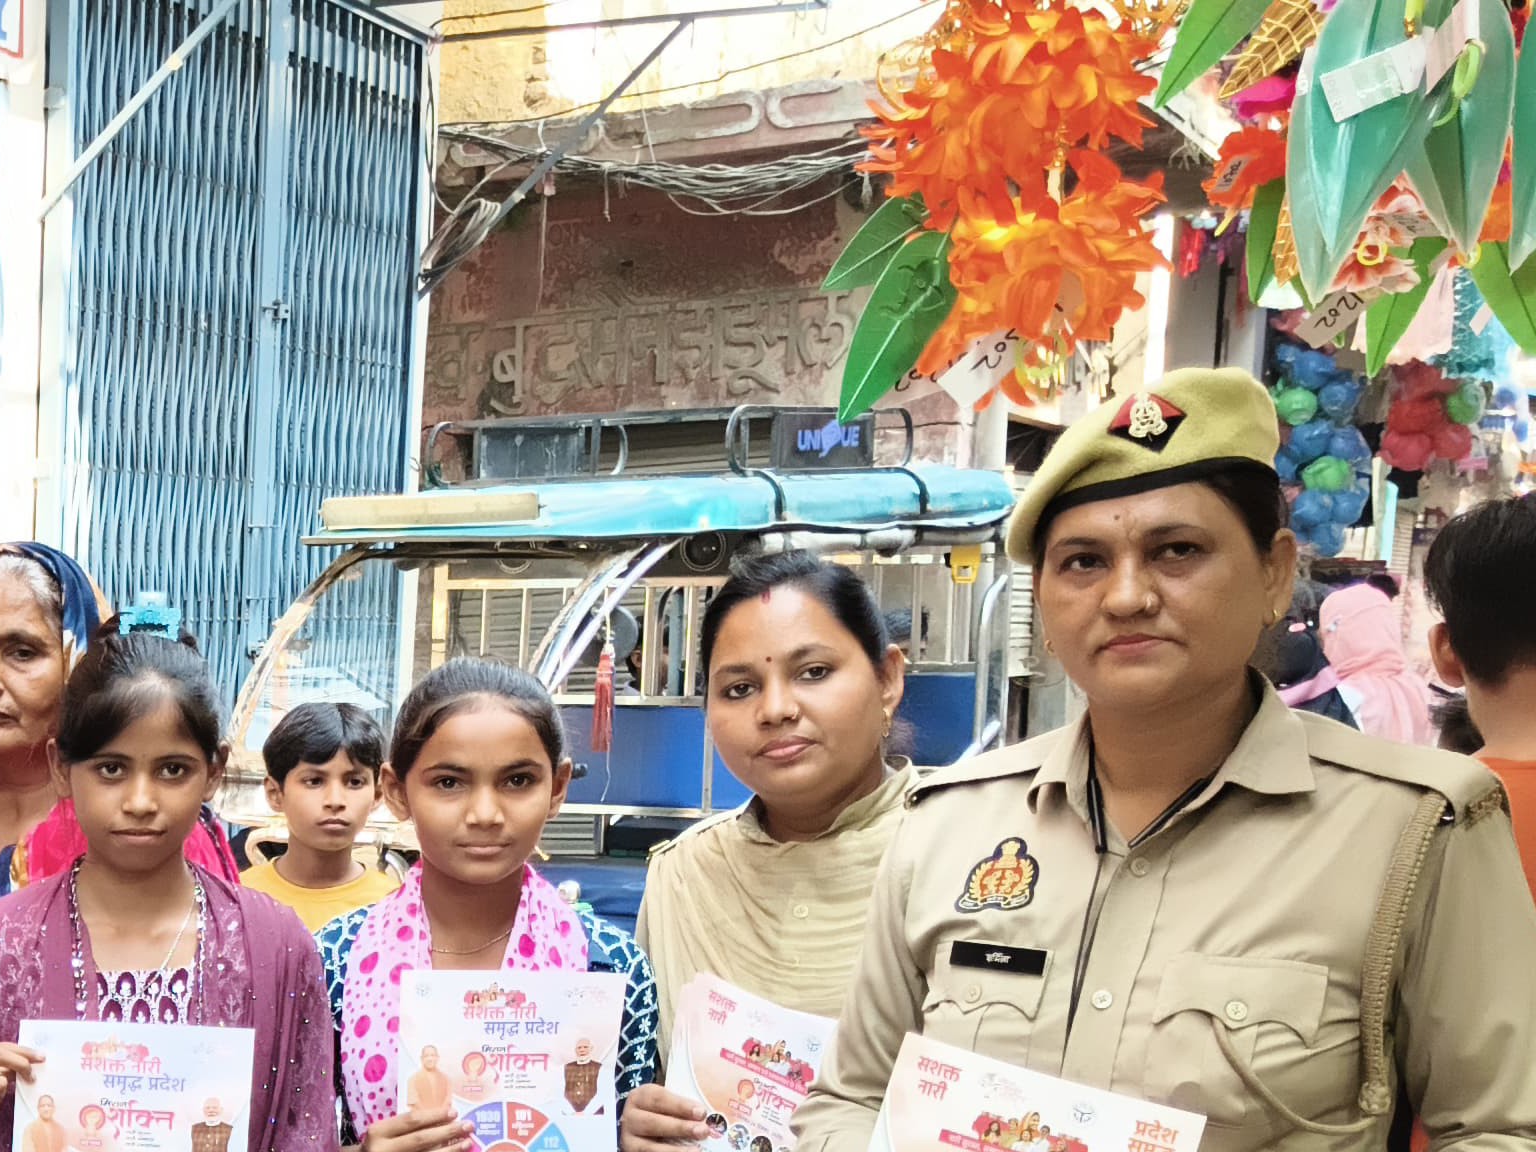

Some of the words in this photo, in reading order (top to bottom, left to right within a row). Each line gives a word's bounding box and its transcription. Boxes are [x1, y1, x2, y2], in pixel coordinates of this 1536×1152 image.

[510, 1001, 537, 1020] नारी
[484, 1021, 520, 1040] समृद्ध
[524, 1016, 560, 1035] प्रदेश
[132, 1056, 161, 1074] नारी
[917, 1055, 964, 1082] सशक्त
[103, 1074, 144, 1095] समृद्ध
[148, 1072, 185, 1092] प्रदेश
[918, 1078, 948, 1101] नारी
[1134, 1119, 1179, 1144] प्रदेश
